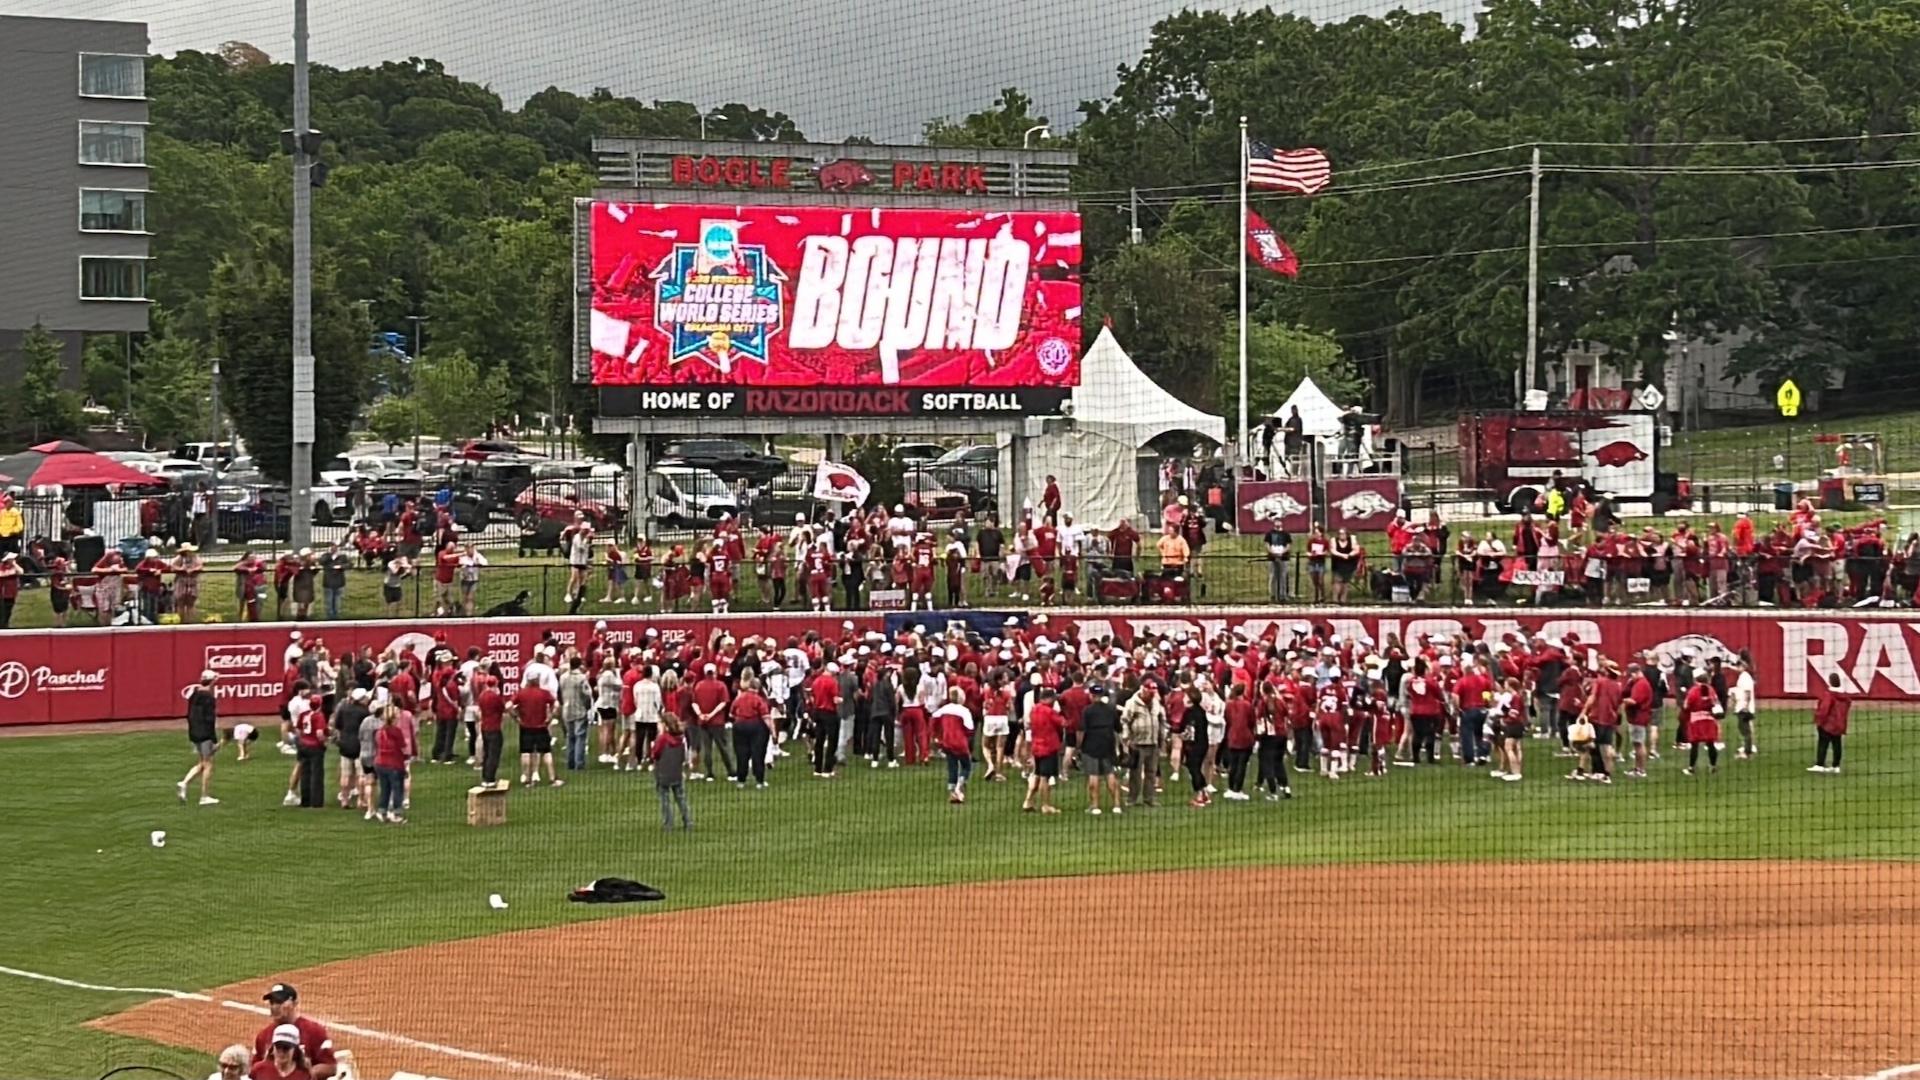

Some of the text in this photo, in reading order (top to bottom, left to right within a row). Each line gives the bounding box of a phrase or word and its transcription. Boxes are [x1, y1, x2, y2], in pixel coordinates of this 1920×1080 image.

[672, 155, 988, 193] BOGLE PARK
[684, 284, 755, 303] COLLEGE
[789, 235, 1030, 350] BOUND
[660, 303, 778, 323] WORLD SERIES
[642, 390, 1022, 412] HOME OF RAZORBACK SOFTBALL
[488, 633, 520, 646] 2000
[208, 654, 263, 668] CRAIN
[488, 649, 520, 662] 2002
[31, 665, 109, 686] Paschal
[213, 682, 283, 698] HYUNDA
